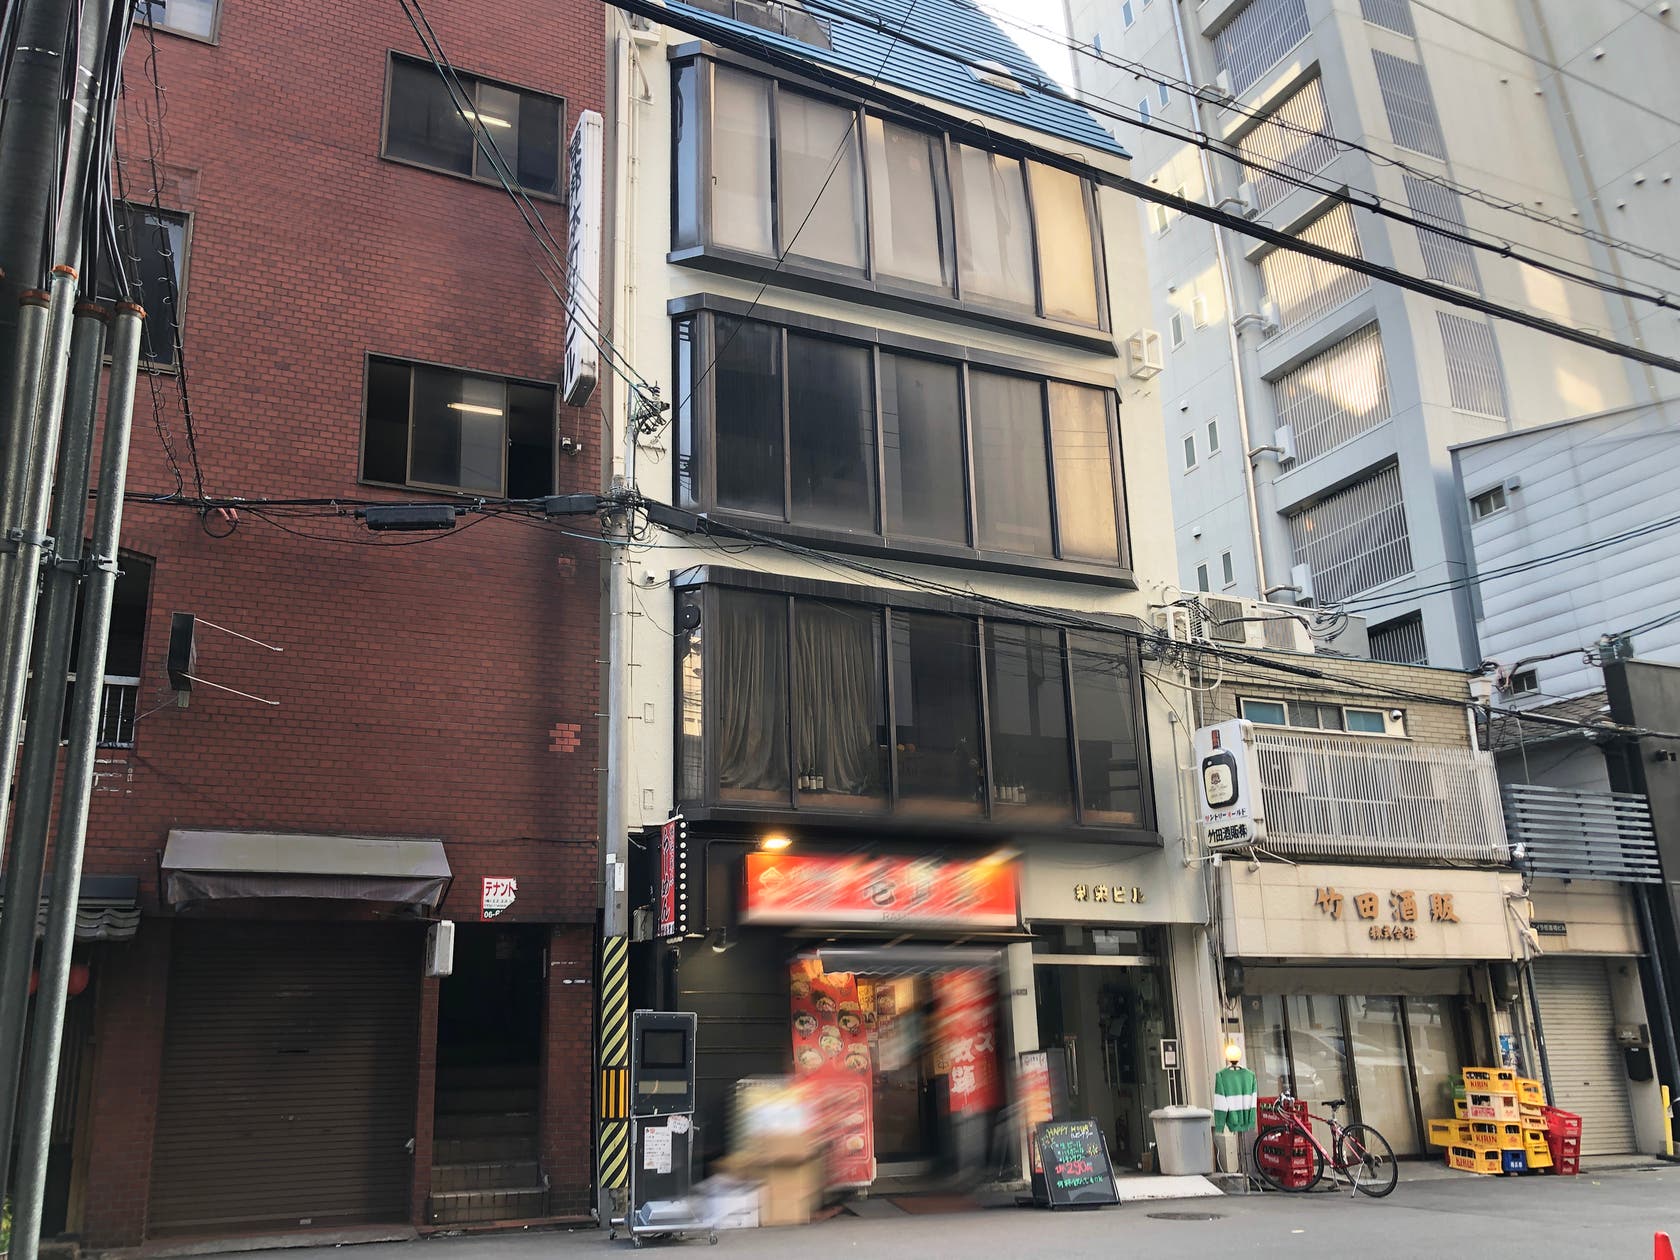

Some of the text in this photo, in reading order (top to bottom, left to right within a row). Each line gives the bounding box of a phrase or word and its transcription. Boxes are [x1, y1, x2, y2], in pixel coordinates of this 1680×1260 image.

[1204, 808, 1247, 823] サントリーオールド
[485, 881, 514, 897] テナント
[1315, 886, 1461, 924] 竹田酒販
[1470, 1081, 1489, 1089] KIRIN
[1475, 1134, 1497, 1144] KIRIN
[1455, 1158, 1475, 1169] KIRIN
